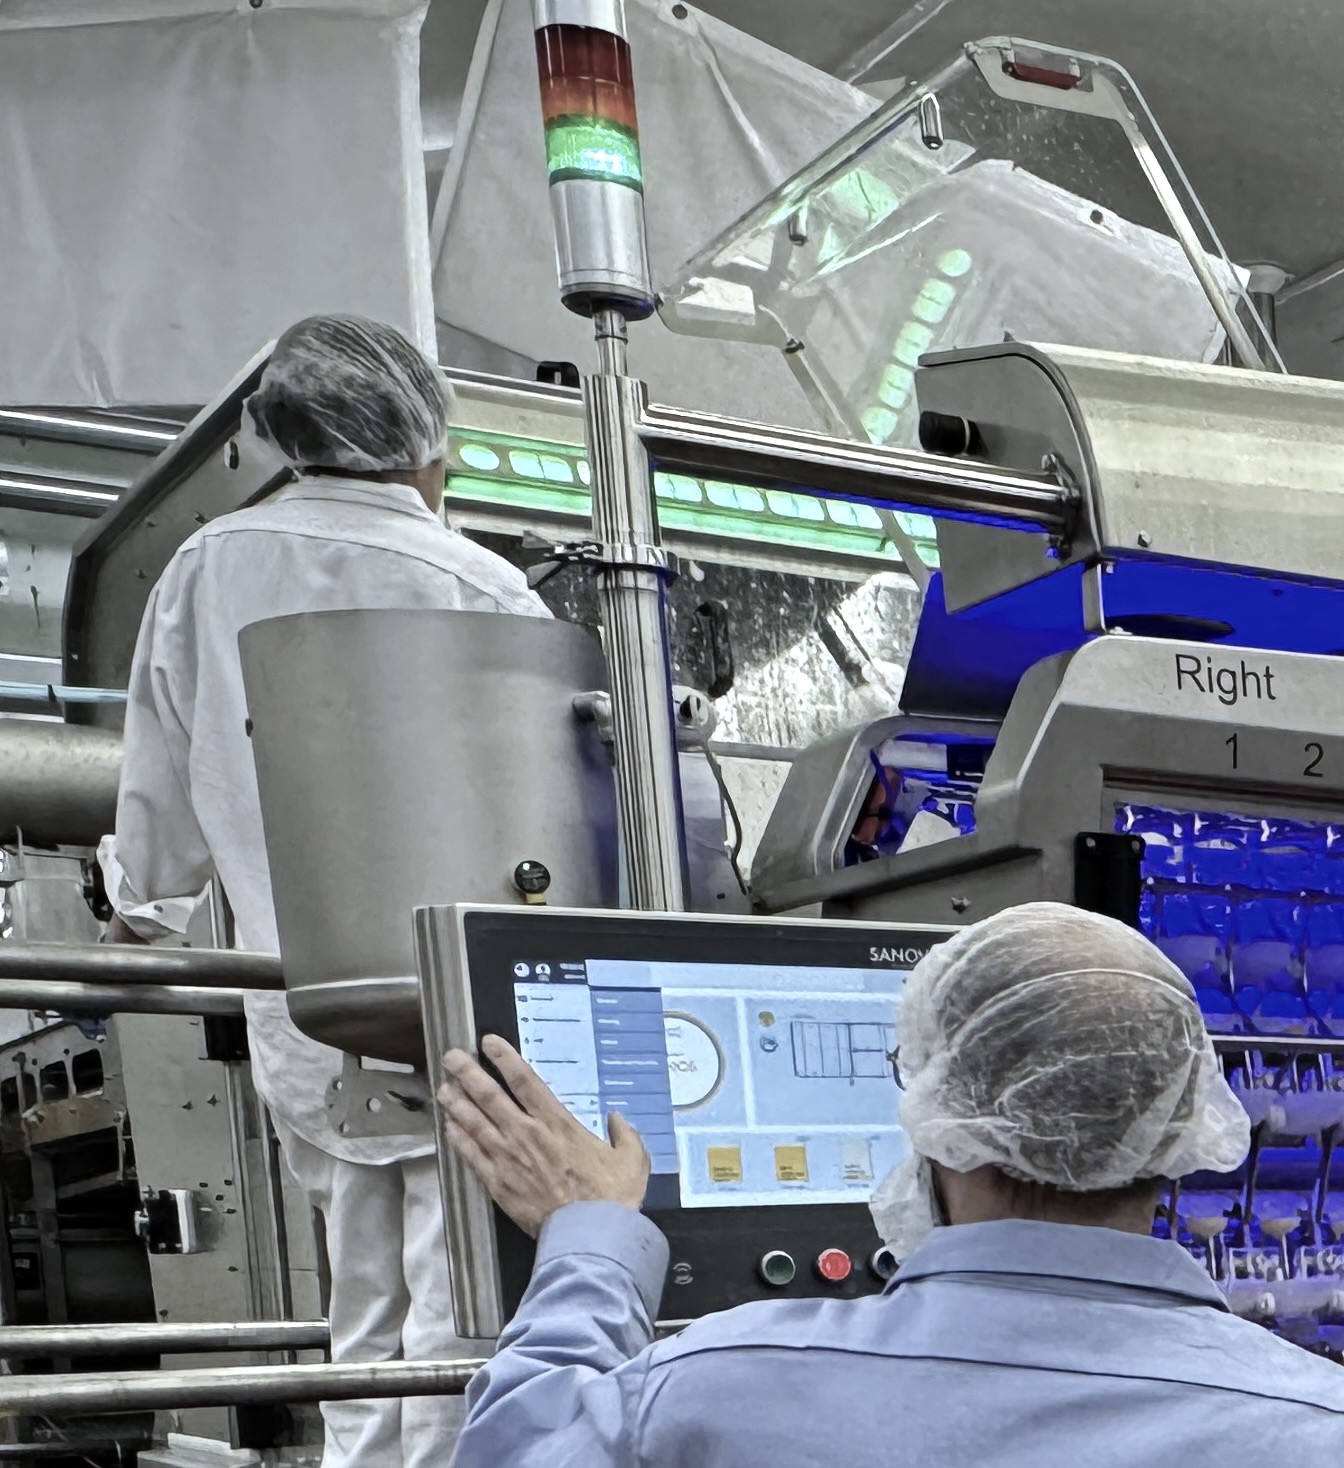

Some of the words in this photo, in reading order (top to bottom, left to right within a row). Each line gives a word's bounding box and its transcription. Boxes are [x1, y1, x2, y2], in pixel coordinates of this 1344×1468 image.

[1175, 653, 1277, 705] Right
[1225, 732, 1238, 770] 1
[1303, 742, 1324, 778] 2
